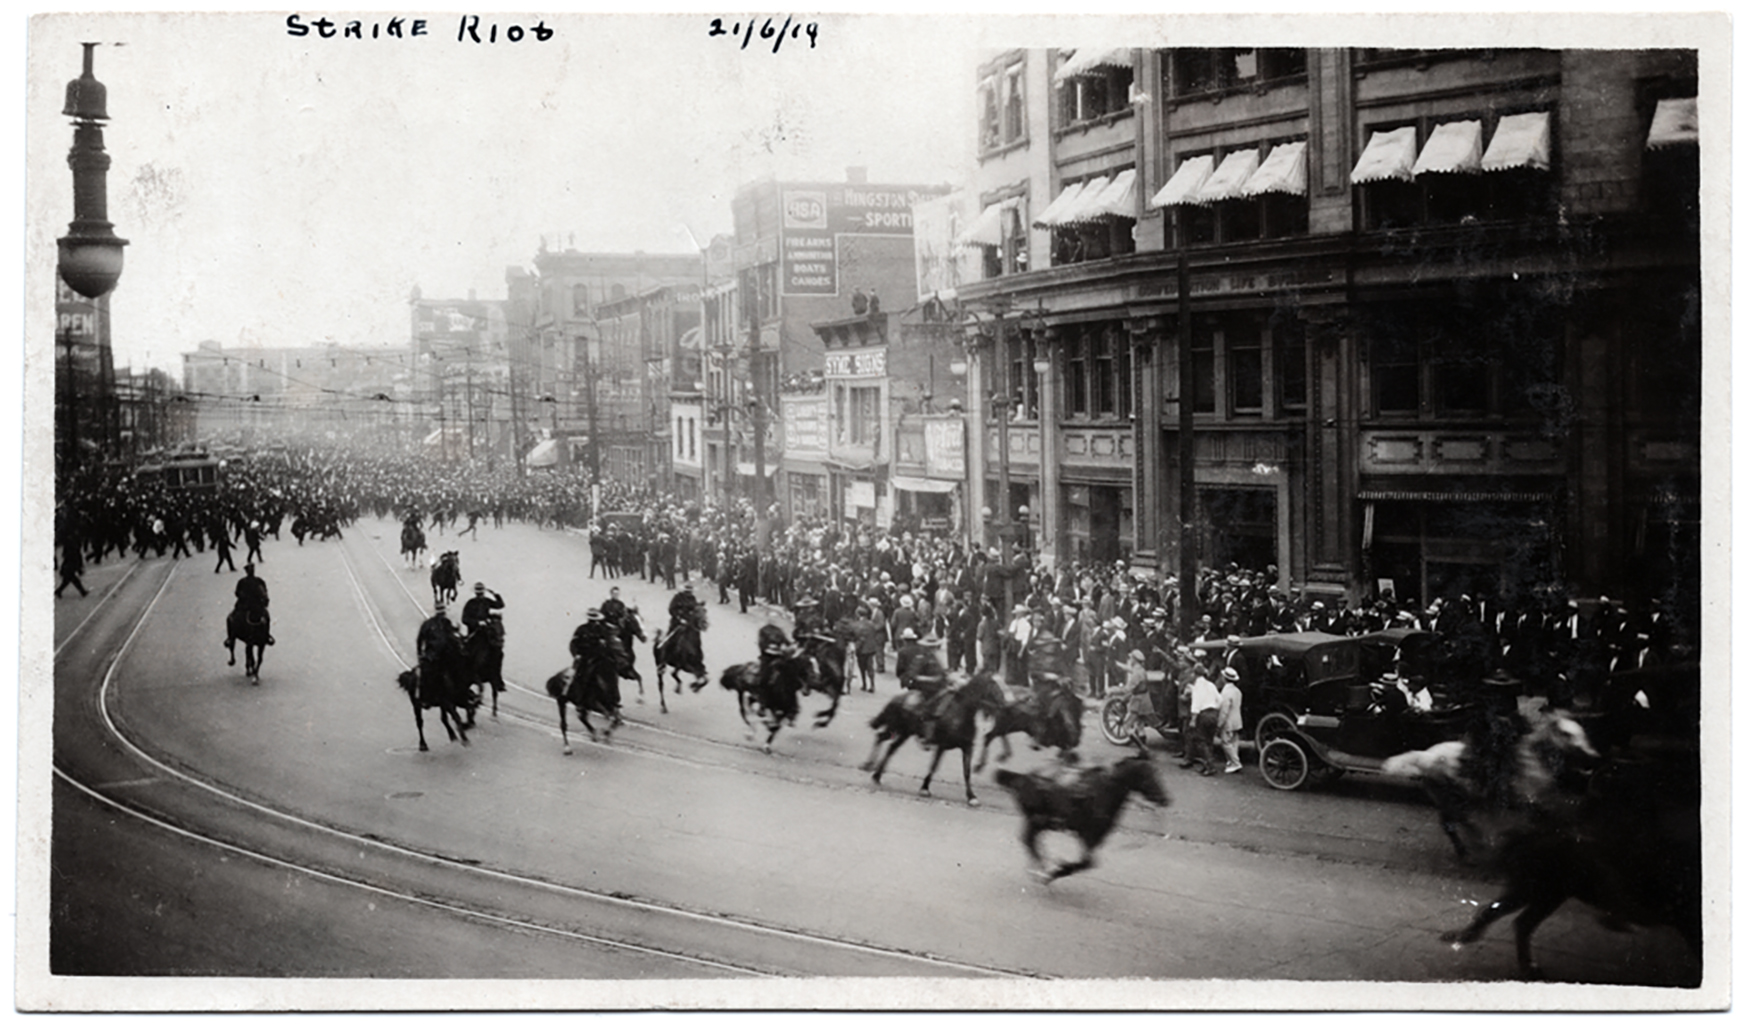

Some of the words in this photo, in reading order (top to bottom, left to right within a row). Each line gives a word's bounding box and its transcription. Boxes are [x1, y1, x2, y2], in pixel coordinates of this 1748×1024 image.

[708, 14, 818, 53] 21/6/19
[793, 263, 826, 273] BOATS
[791, 276, 831, 287] CANOES
[854, 352, 885, 375] SIGNS
